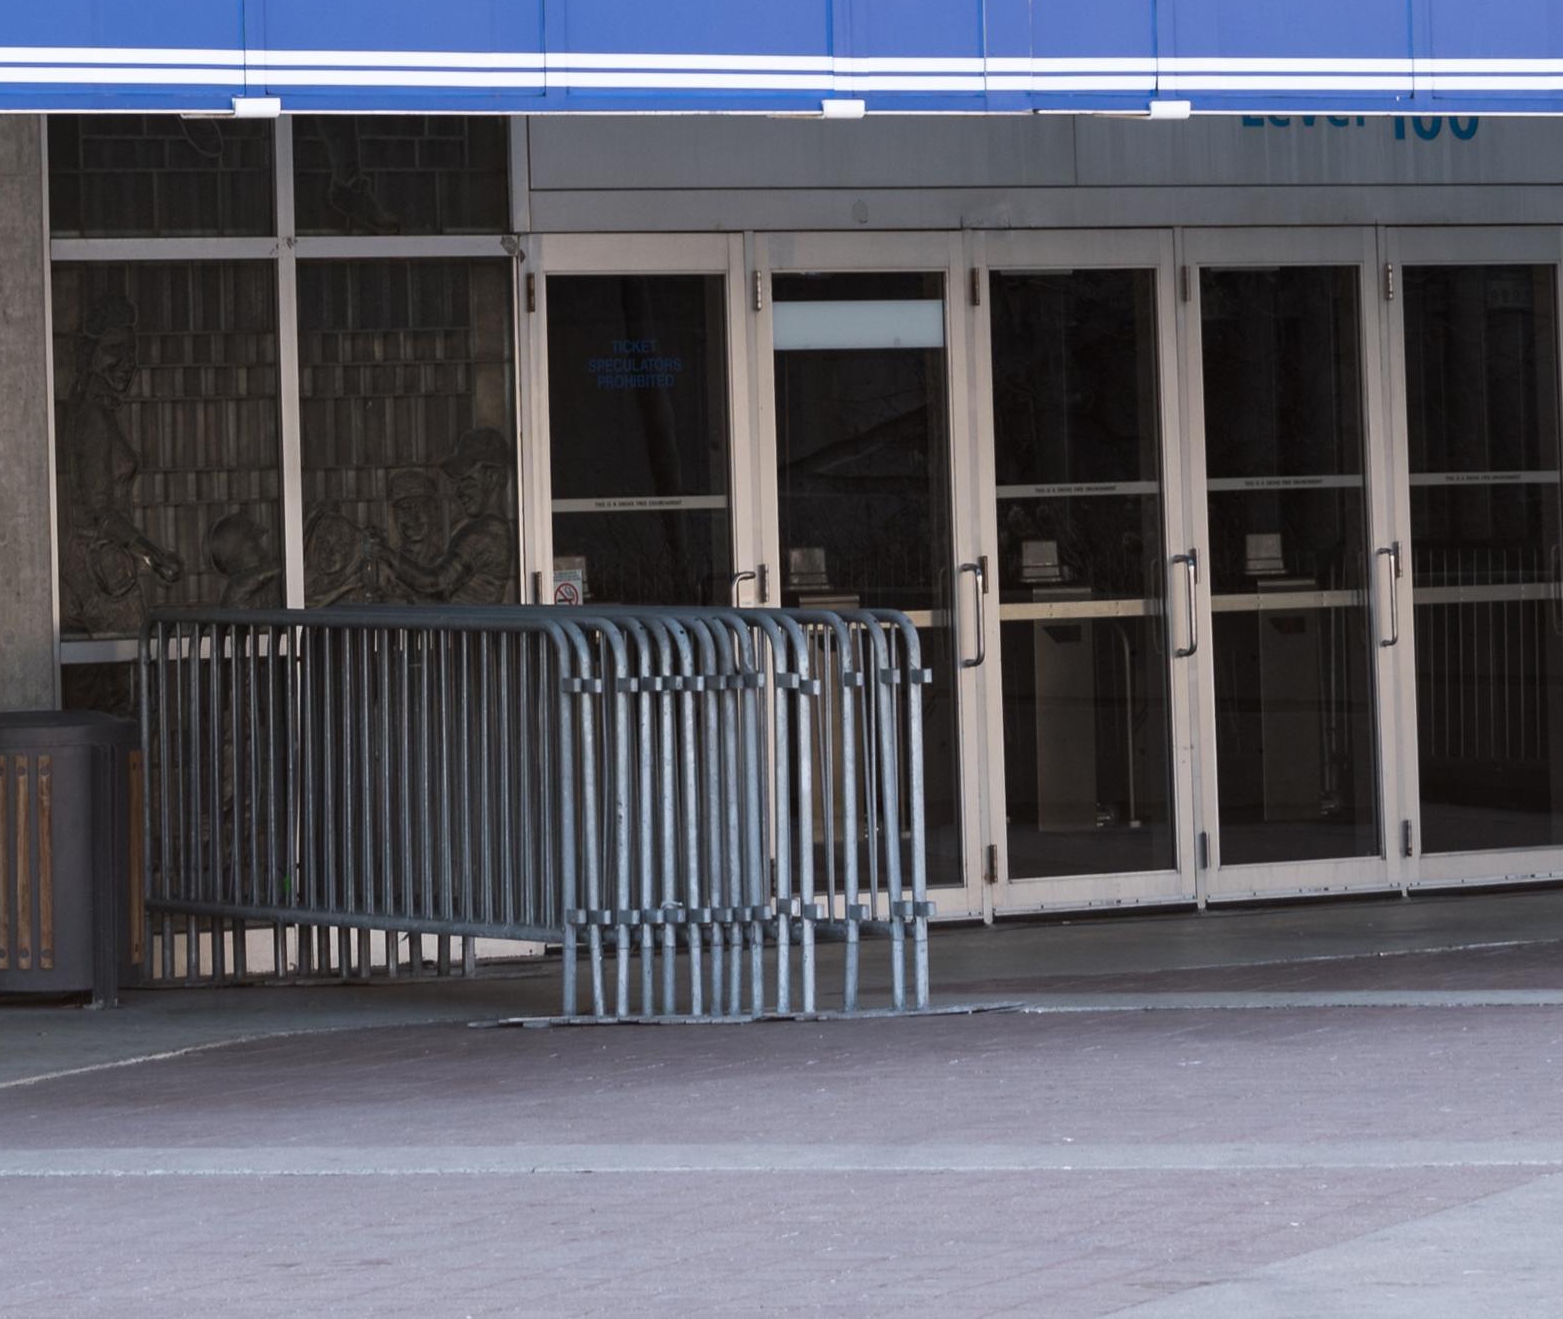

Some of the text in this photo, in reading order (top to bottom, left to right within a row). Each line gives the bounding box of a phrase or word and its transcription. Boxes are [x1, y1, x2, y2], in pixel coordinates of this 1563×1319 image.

[611, 339, 658, 354] TICKET
[588, 357, 683, 372] SPECULATORS
[597, 373, 676, 389] PROHIBITED
